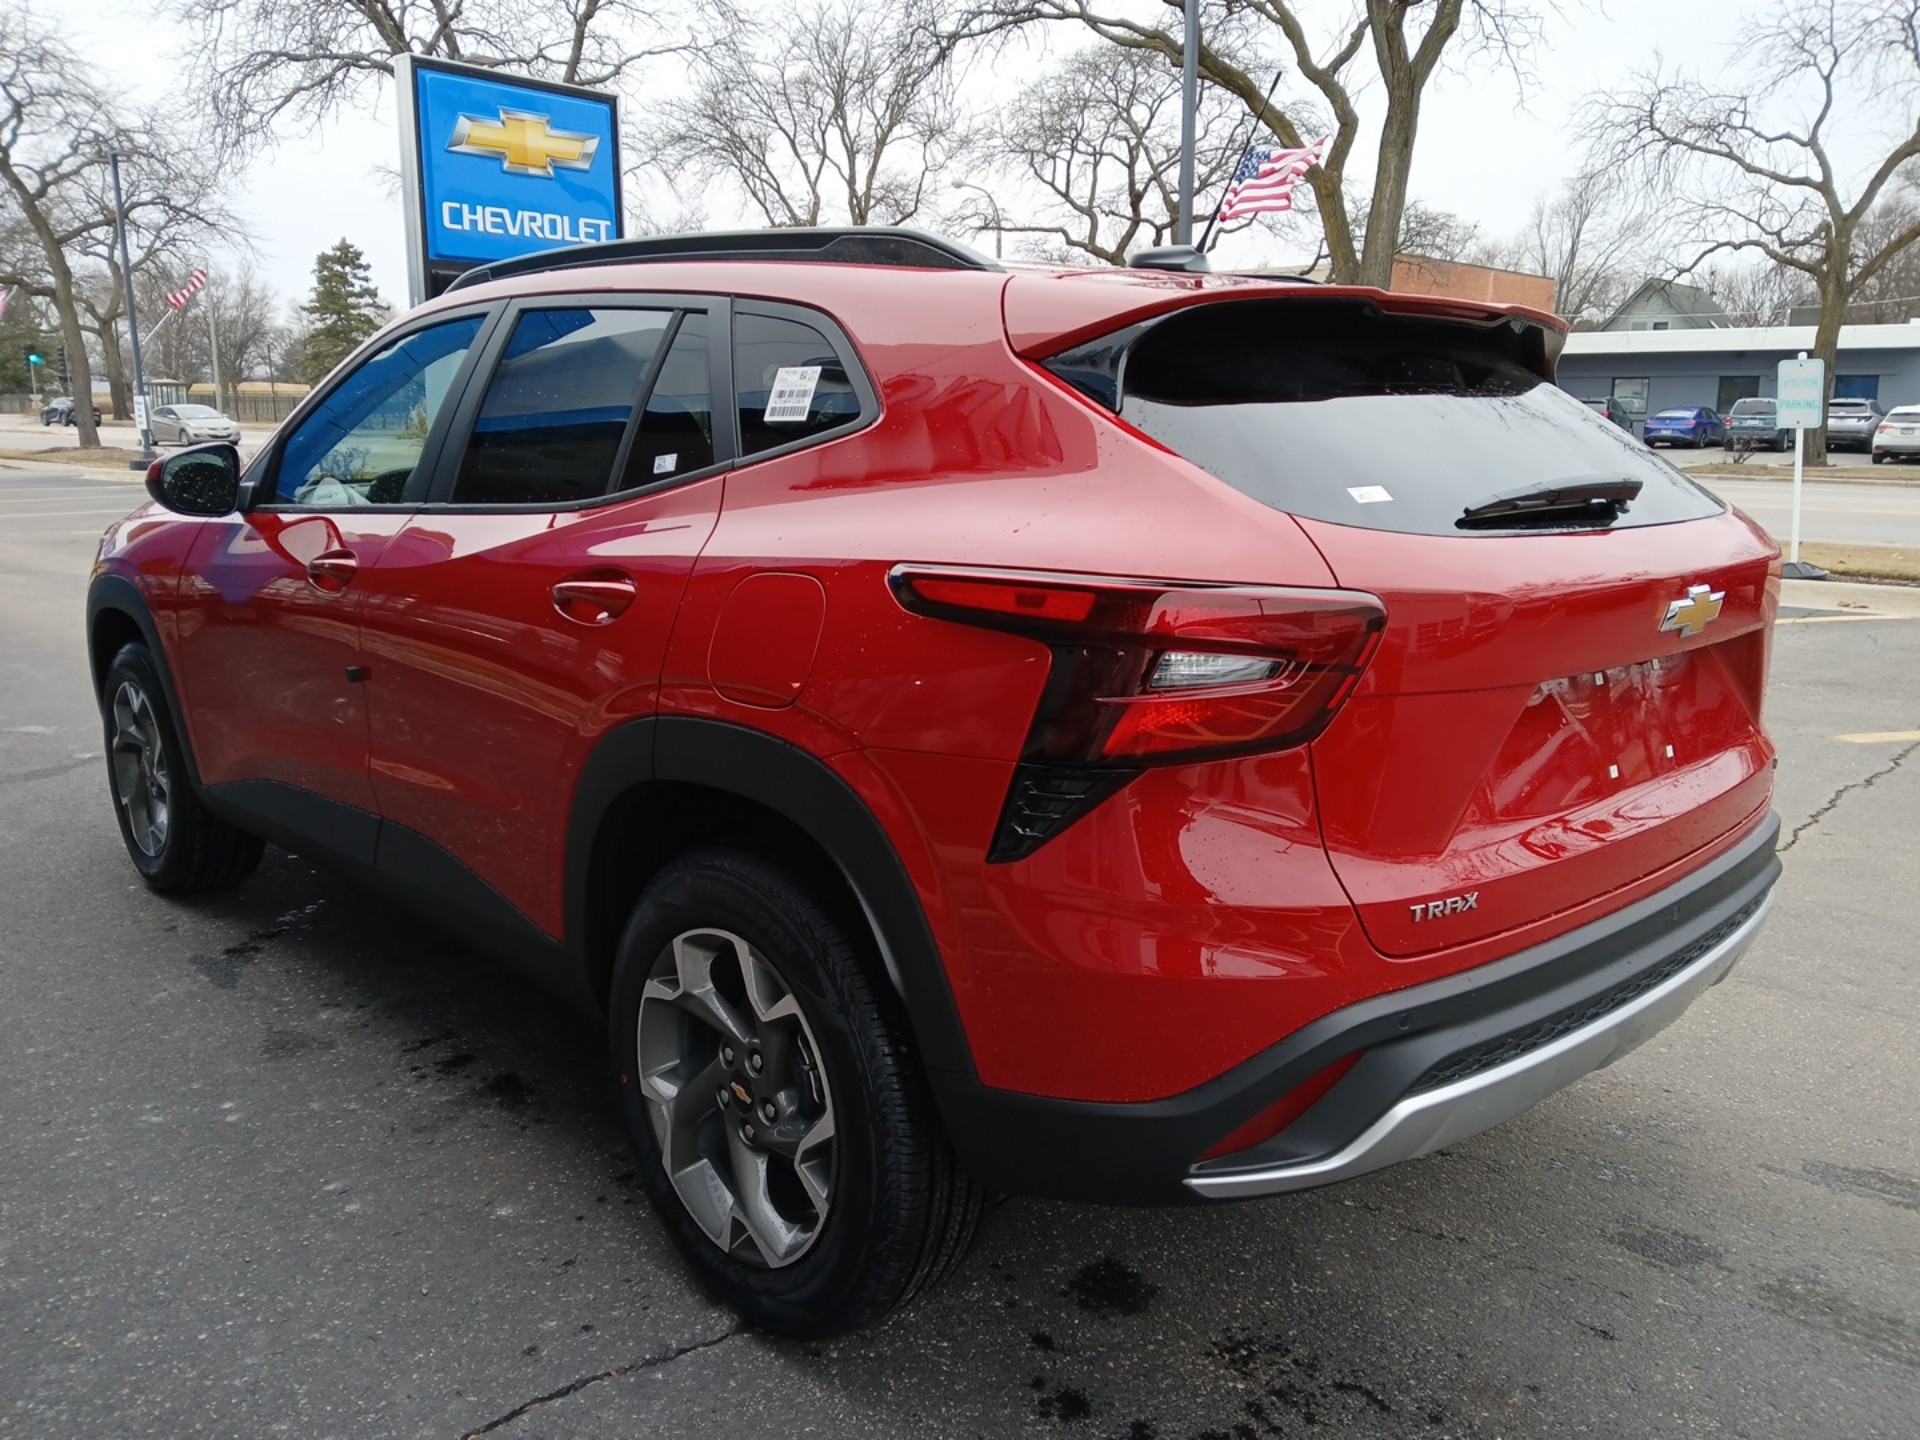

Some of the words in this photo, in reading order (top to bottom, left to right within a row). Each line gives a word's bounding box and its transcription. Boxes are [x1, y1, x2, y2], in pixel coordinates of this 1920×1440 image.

[442, 201, 611, 243] CHEVROLET
[1780, 399, 1819, 410] PARKING
[1410, 891, 1479, 923] TRAX
